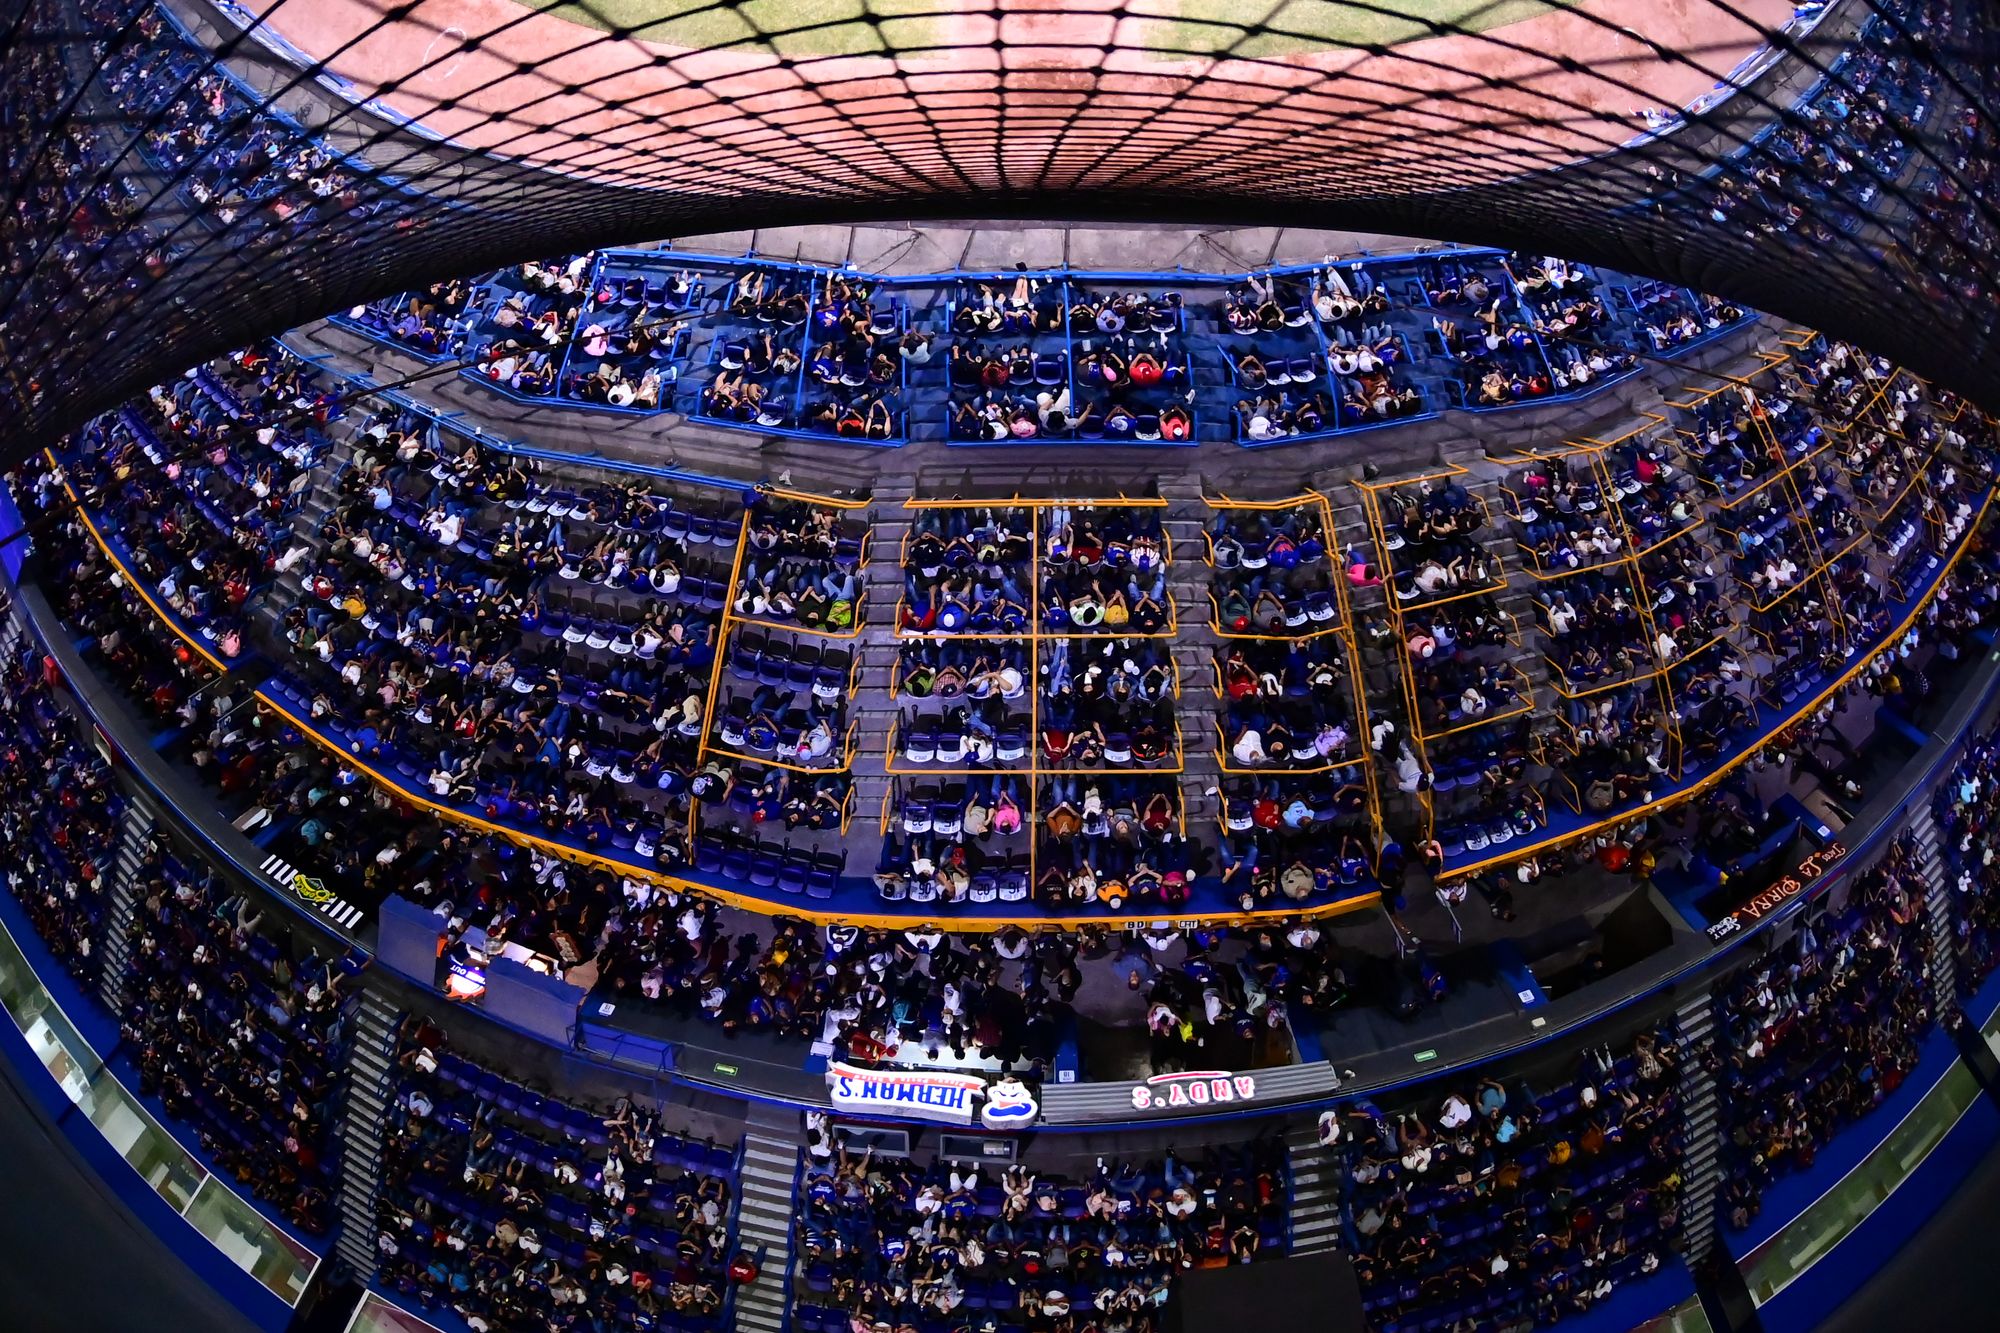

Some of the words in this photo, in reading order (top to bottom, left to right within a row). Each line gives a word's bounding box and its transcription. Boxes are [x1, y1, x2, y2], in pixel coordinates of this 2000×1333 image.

[1799, 855, 1822, 877] LA
[1008, 880, 1020, 894] 16
[1741, 874, 1801, 918] PIRRA
[450, 964, 467, 975] OUT
[839, 1076, 966, 1109] HERMAN'S
[1132, 1076, 1255, 1109] ANDY'S
